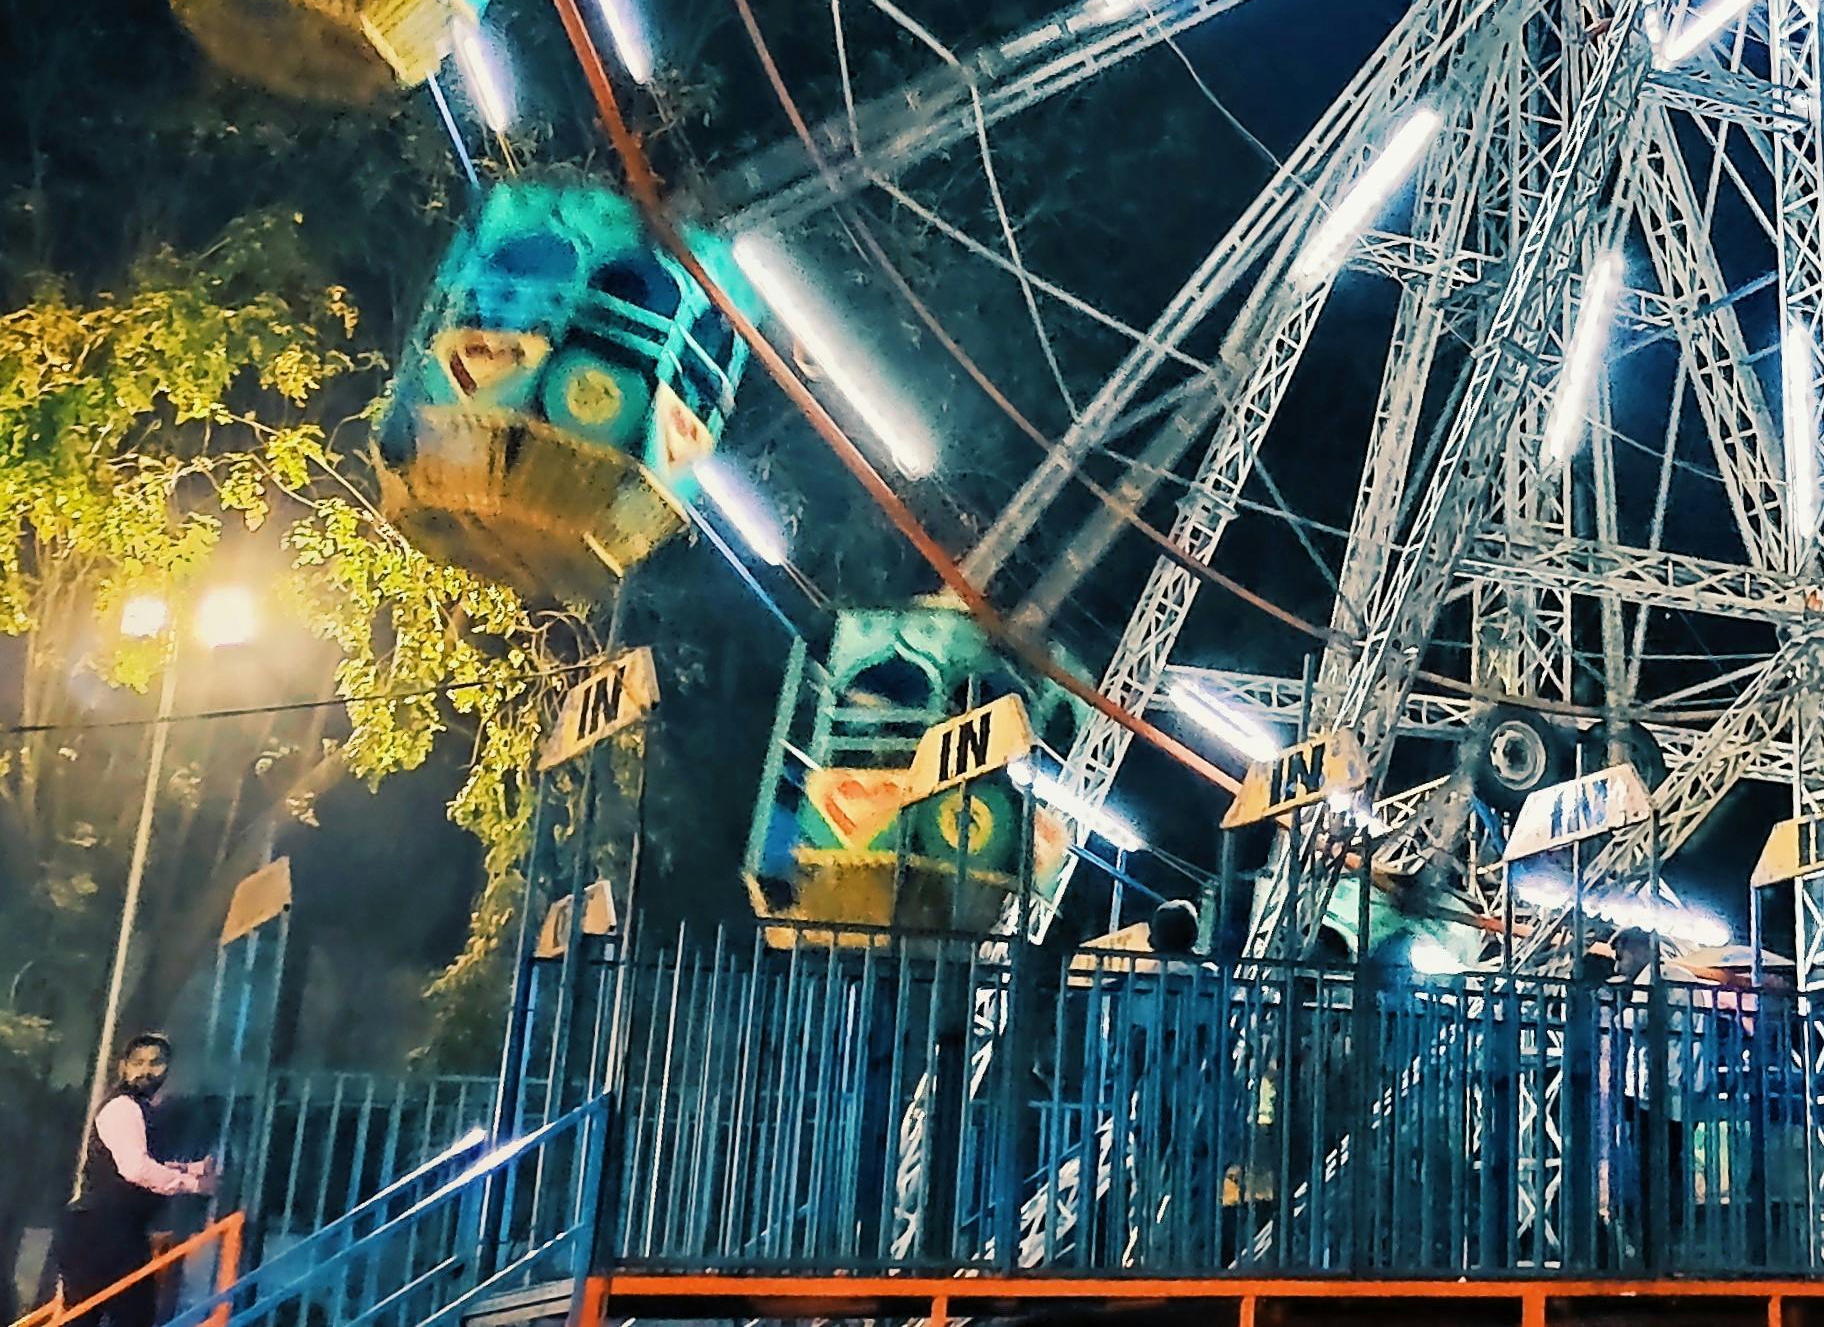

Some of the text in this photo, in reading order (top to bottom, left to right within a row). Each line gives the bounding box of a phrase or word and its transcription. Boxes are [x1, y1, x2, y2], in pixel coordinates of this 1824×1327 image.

[577, 664, 626, 741] IN
[939, 709, 992, 782] IN
[1270, 742, 1326, 807] IN
[1551, 778, 1609, 840] IN
